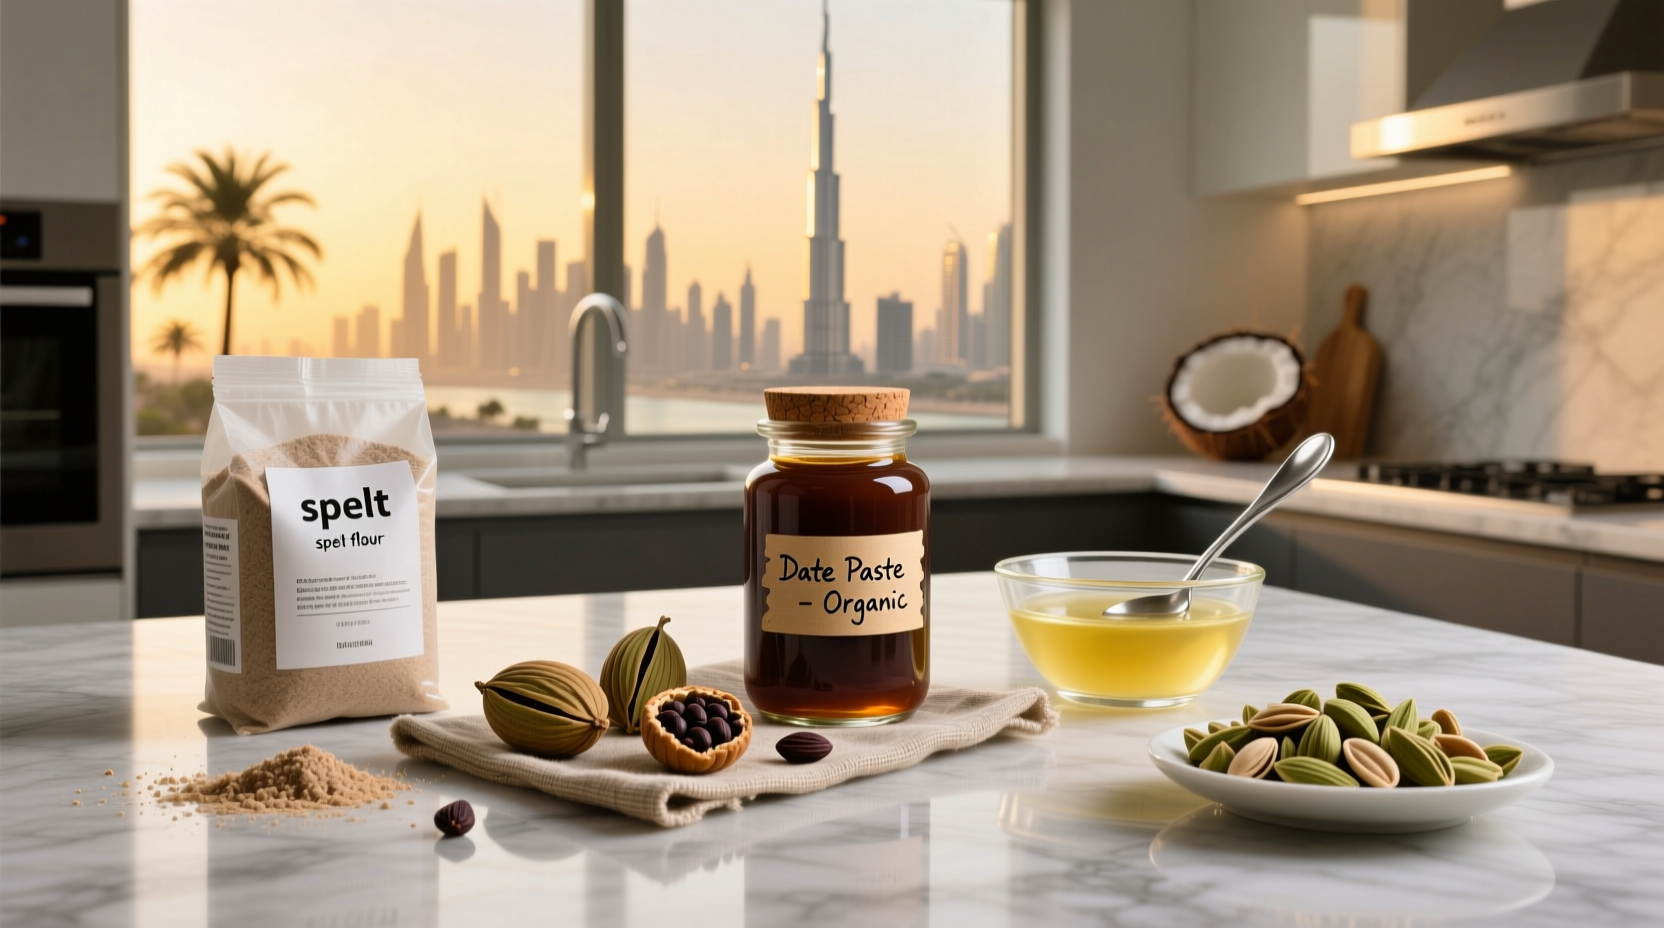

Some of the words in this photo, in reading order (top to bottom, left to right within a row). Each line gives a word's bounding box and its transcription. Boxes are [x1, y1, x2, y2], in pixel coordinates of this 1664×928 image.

[301, 487, 391, 530] spelt
[350, 531, 385, 547] flour
[779, 554, 836, 582] Date
[845, 556, 905, 582] Paste
[823, 590, 908, 626] Organic
